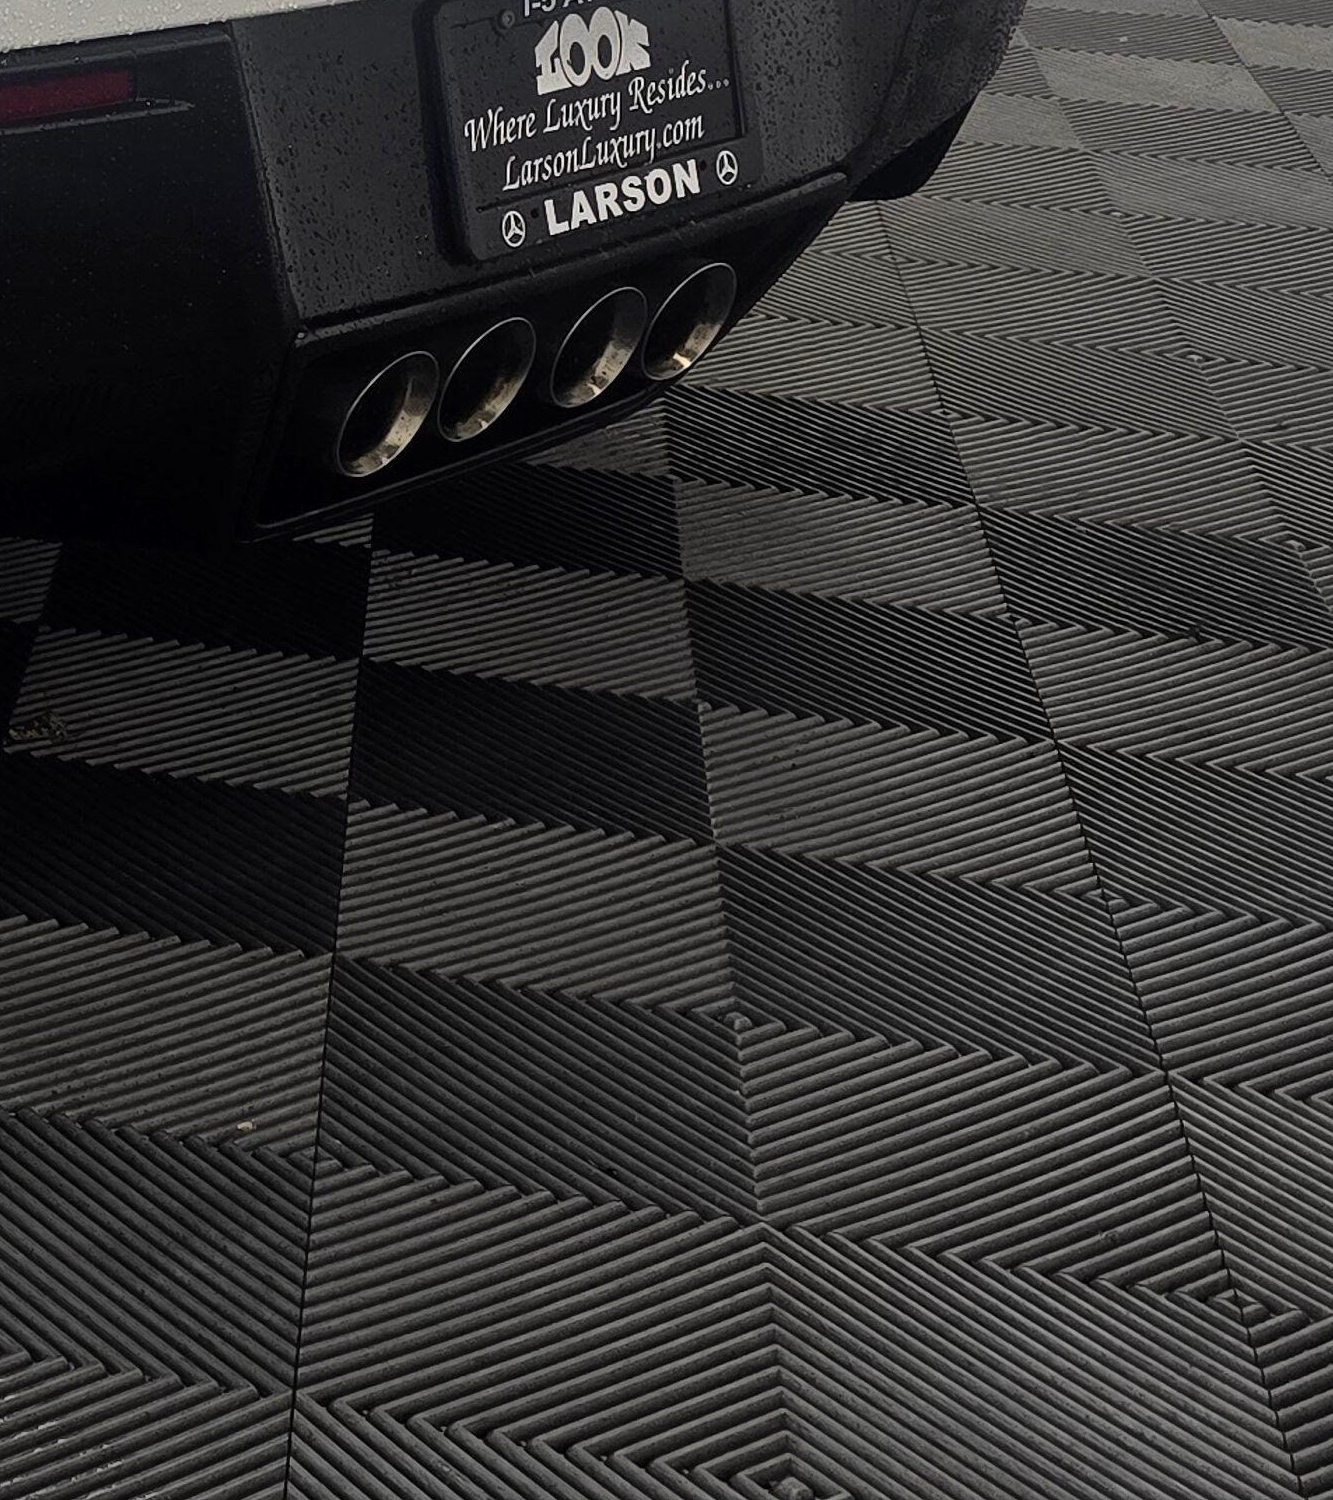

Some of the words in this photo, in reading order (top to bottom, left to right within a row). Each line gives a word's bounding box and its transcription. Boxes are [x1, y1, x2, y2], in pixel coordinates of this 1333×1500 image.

[463, 106, 537, 153] Where
[543, 90, 621, 133] Luxury
[628, 59, 730, 114] Resides...
[501, 114, 706, 192] LarsonLuxury.com
[544, 158, 702, 236] LARSON
